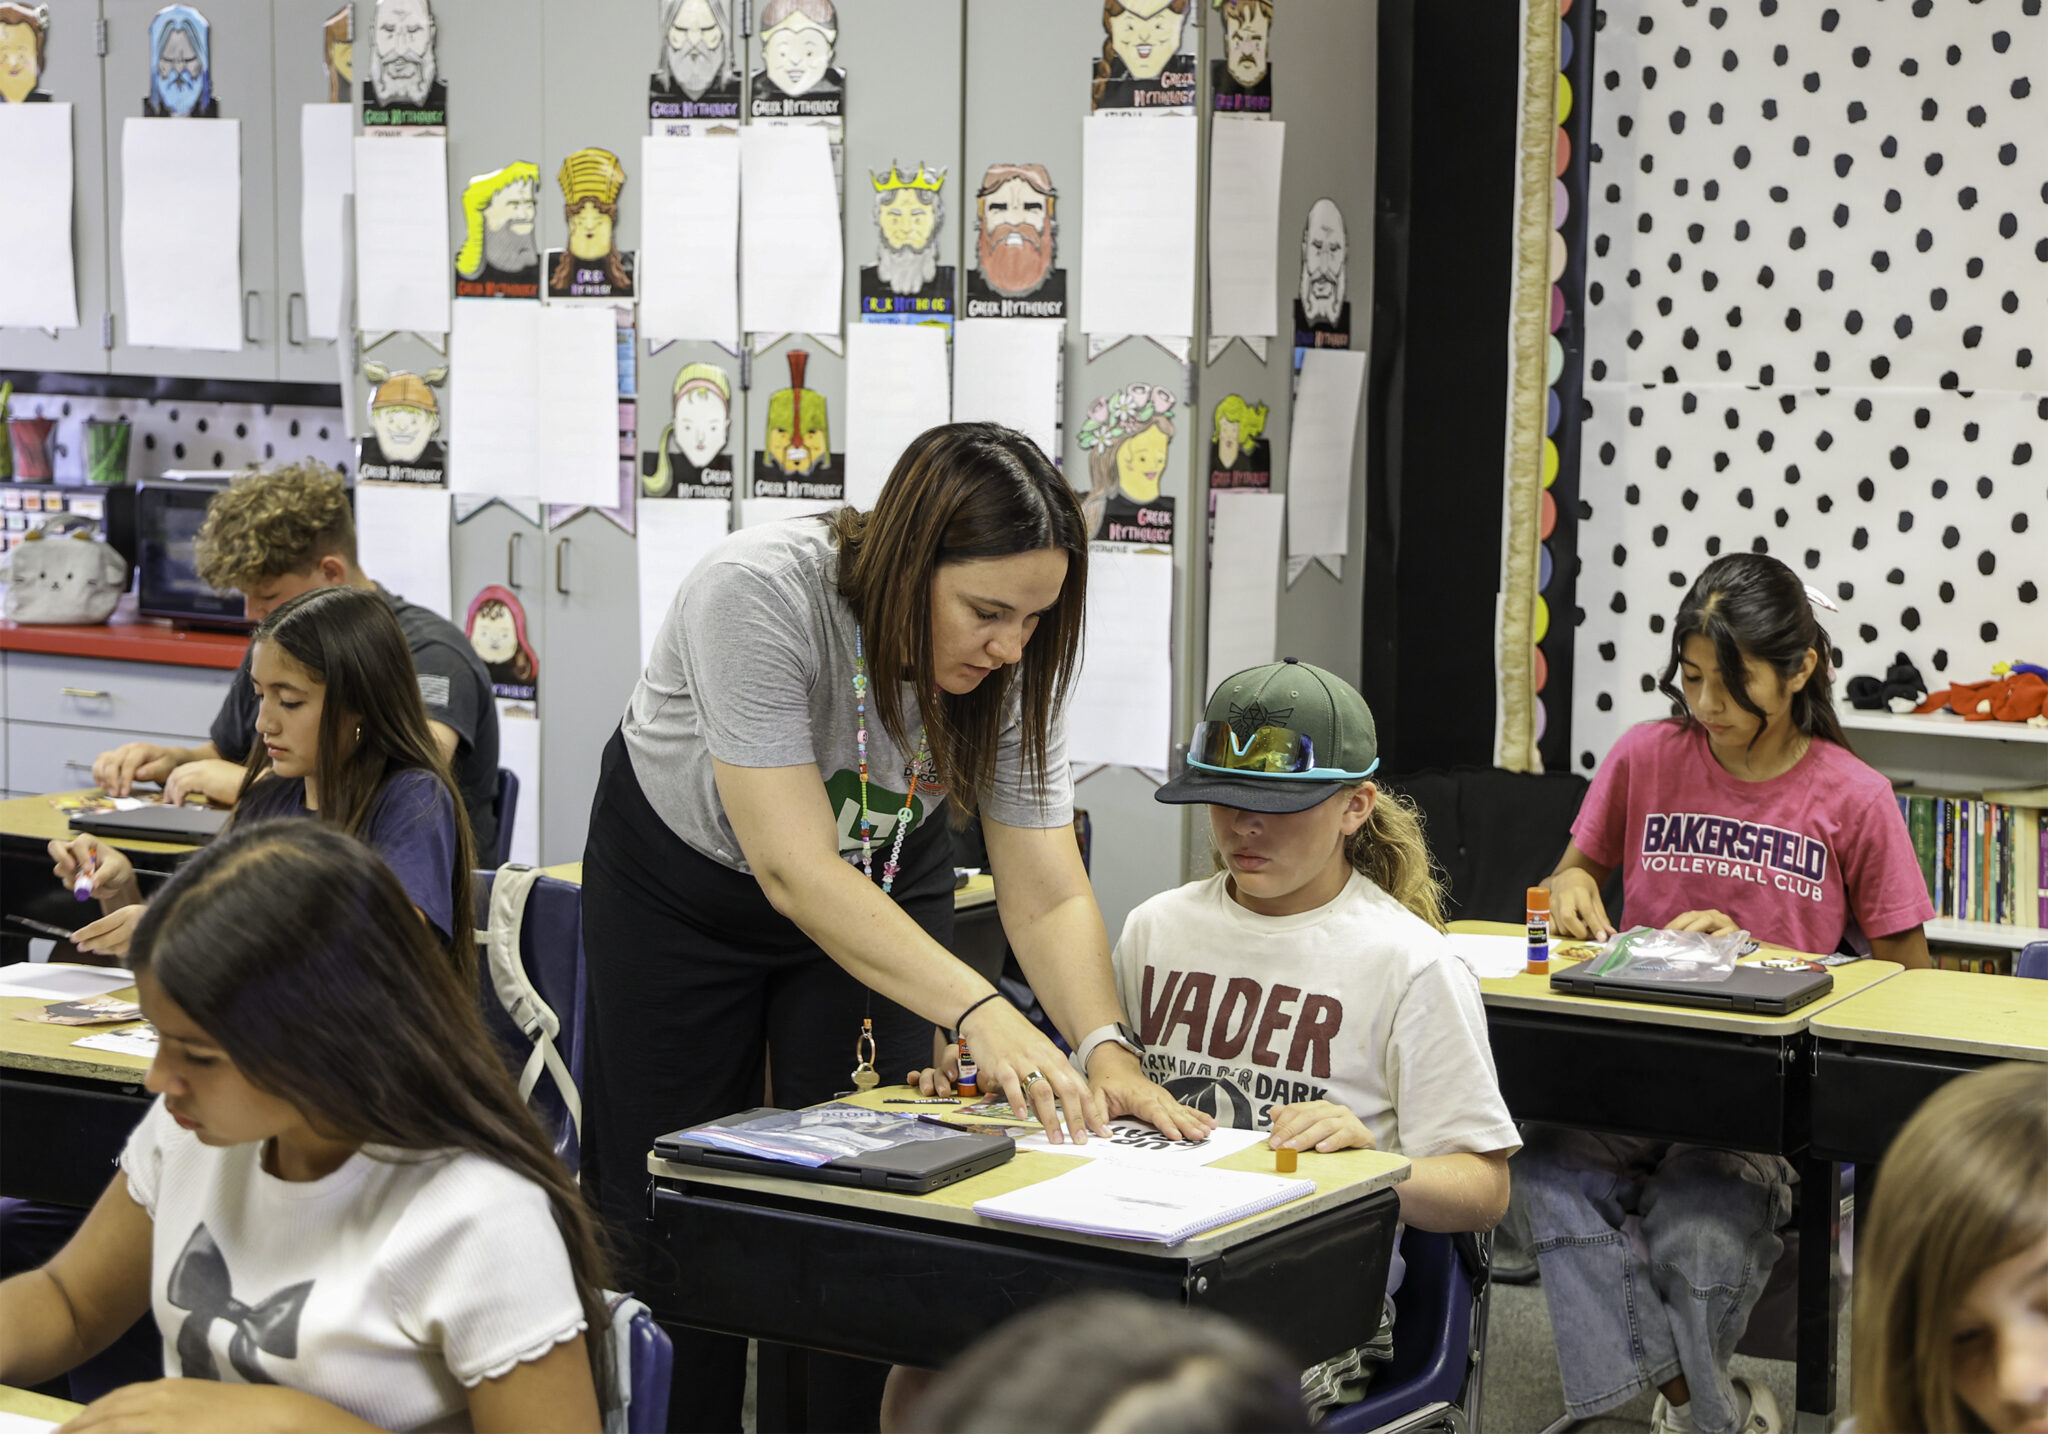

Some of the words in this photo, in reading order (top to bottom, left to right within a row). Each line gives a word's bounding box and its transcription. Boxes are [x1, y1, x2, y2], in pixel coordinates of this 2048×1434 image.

[1642, 813, 1828, 884] BAKERSFIELD
[1641, 857, 1768, 885] VOLLEYBALL
[1774, 874, 1824, 902] CLUB
[1140, 965, 1343, 1078] VADER
[1255, 1072, 1329, 1105] DARK
